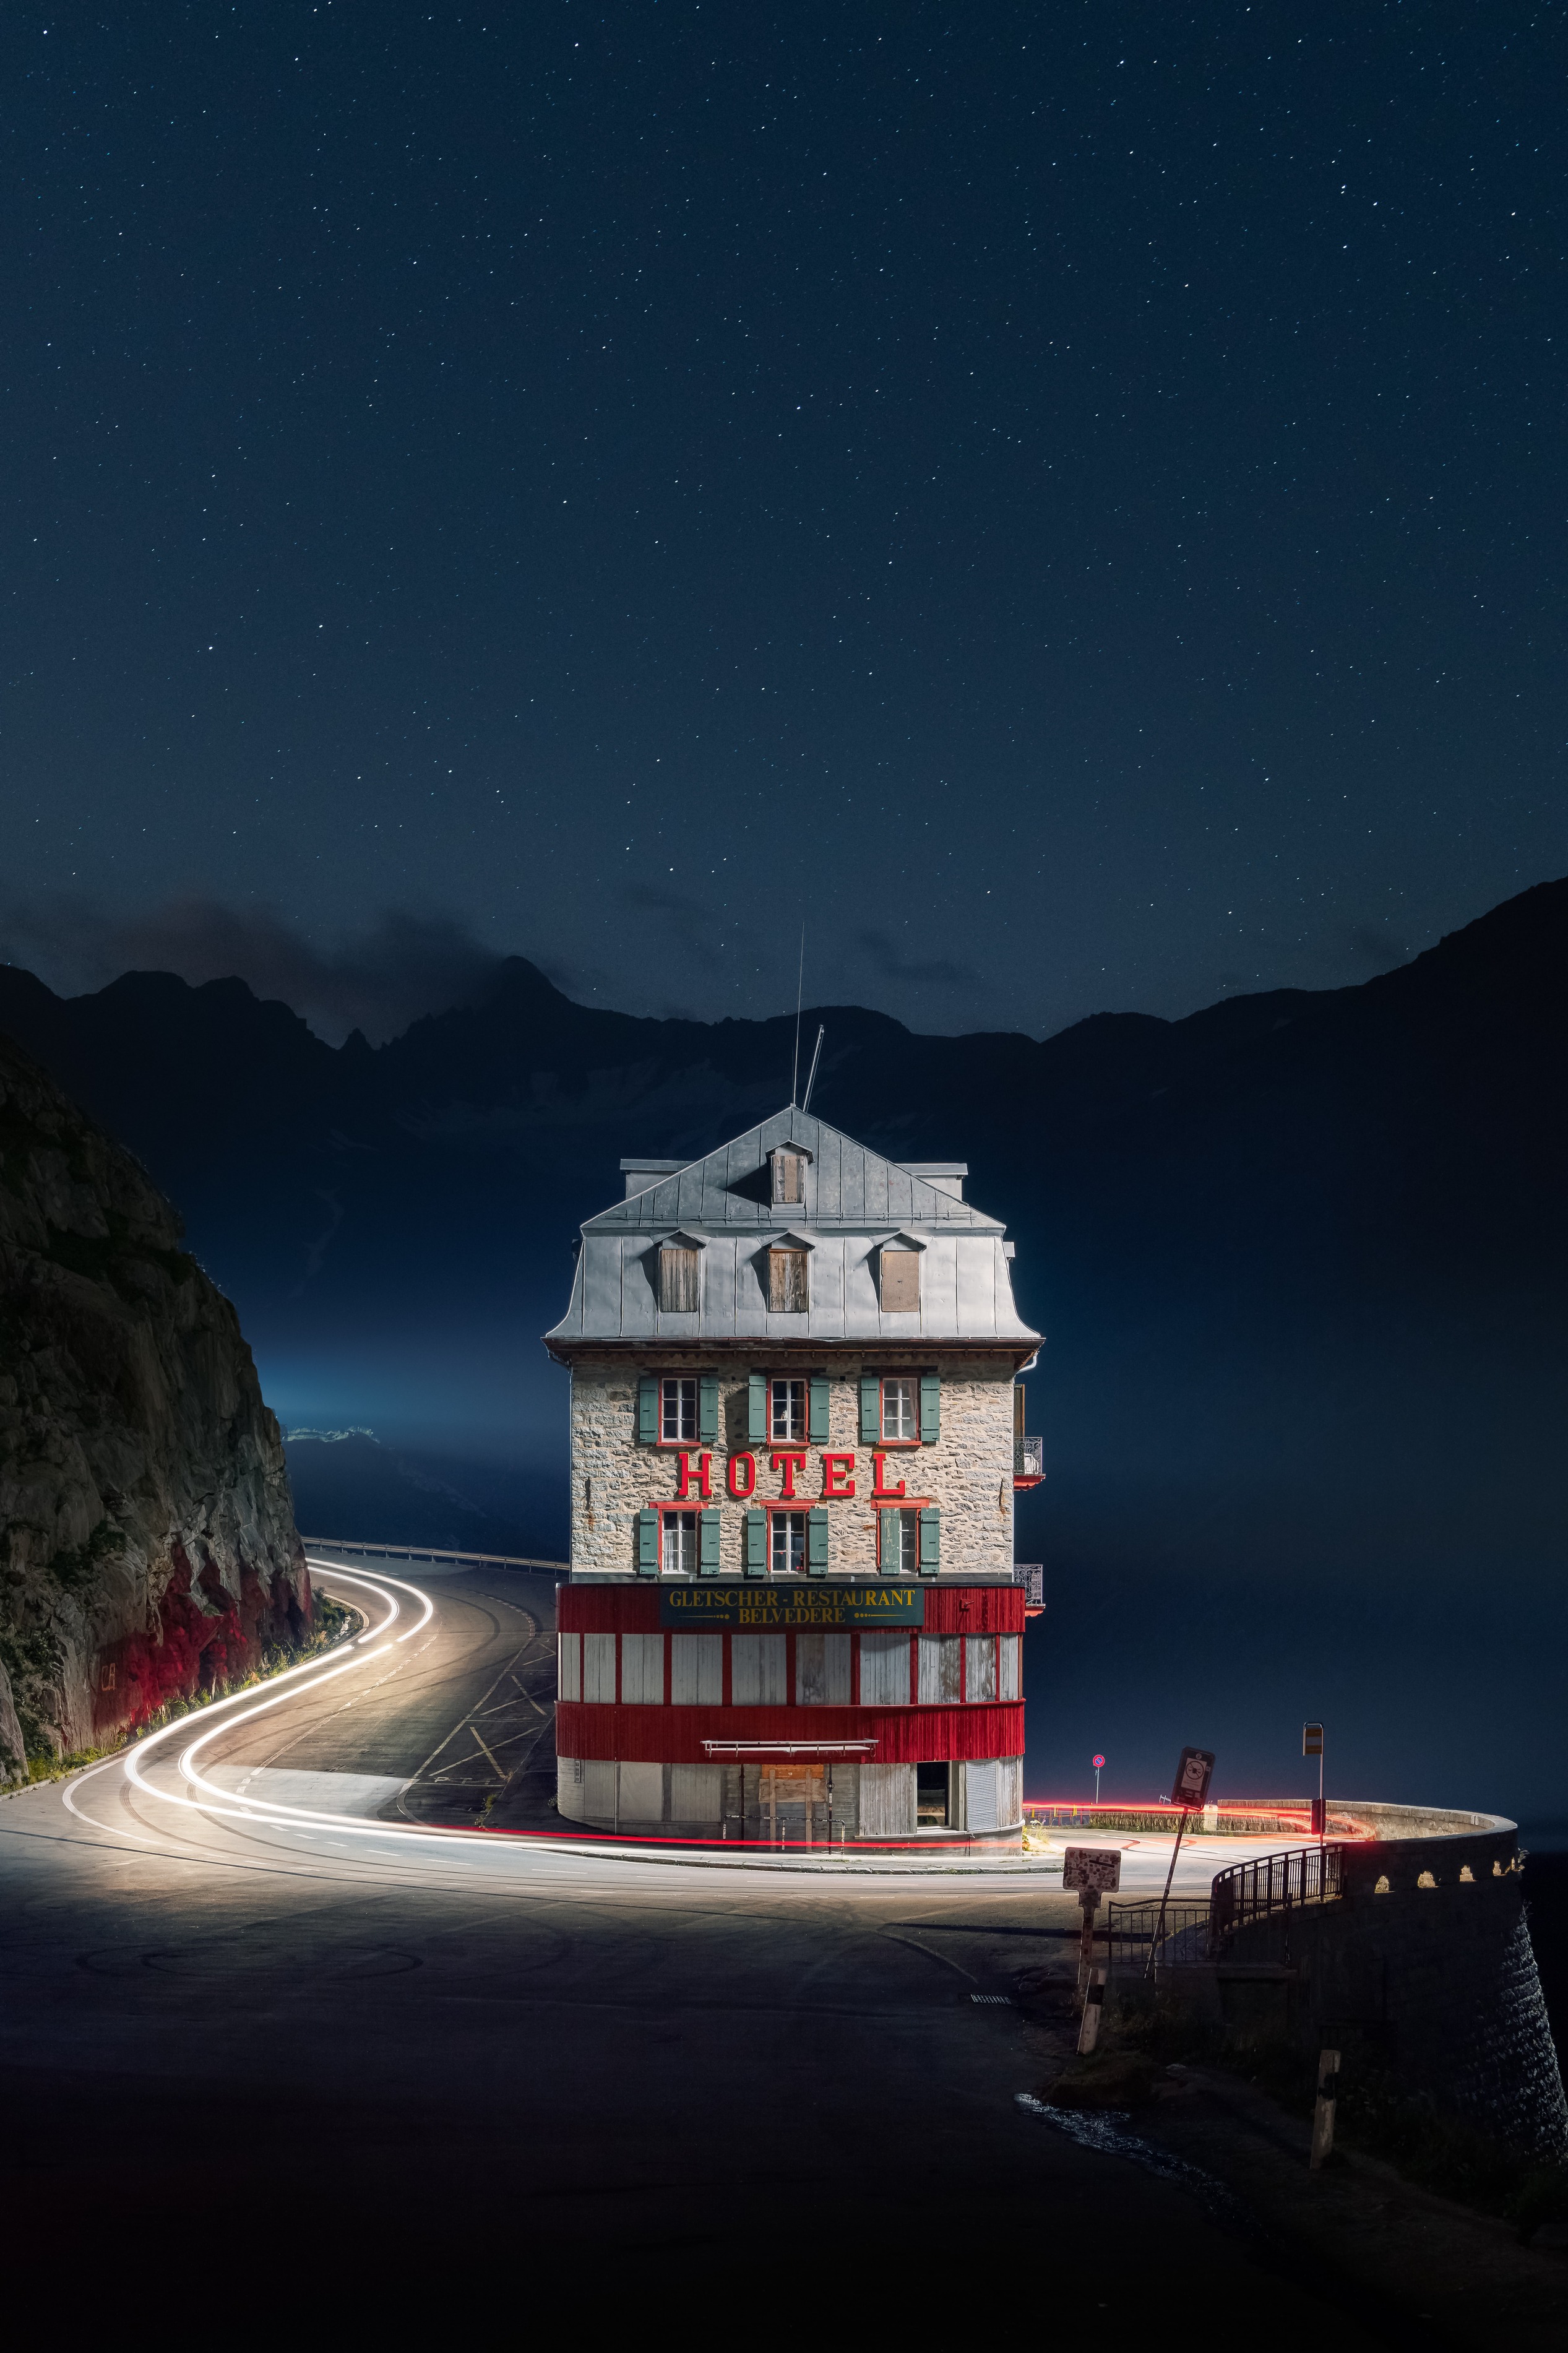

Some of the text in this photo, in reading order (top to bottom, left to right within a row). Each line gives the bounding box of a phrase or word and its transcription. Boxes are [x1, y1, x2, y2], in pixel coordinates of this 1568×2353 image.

[679, 1451, 905, 1496] HOTEL
[670, 1591, 778, 1607] GLETSCHER
[793, 1590, 915, 1606] RESTAURANT
[738, 1608, 846, 1623] BELVEDERE
